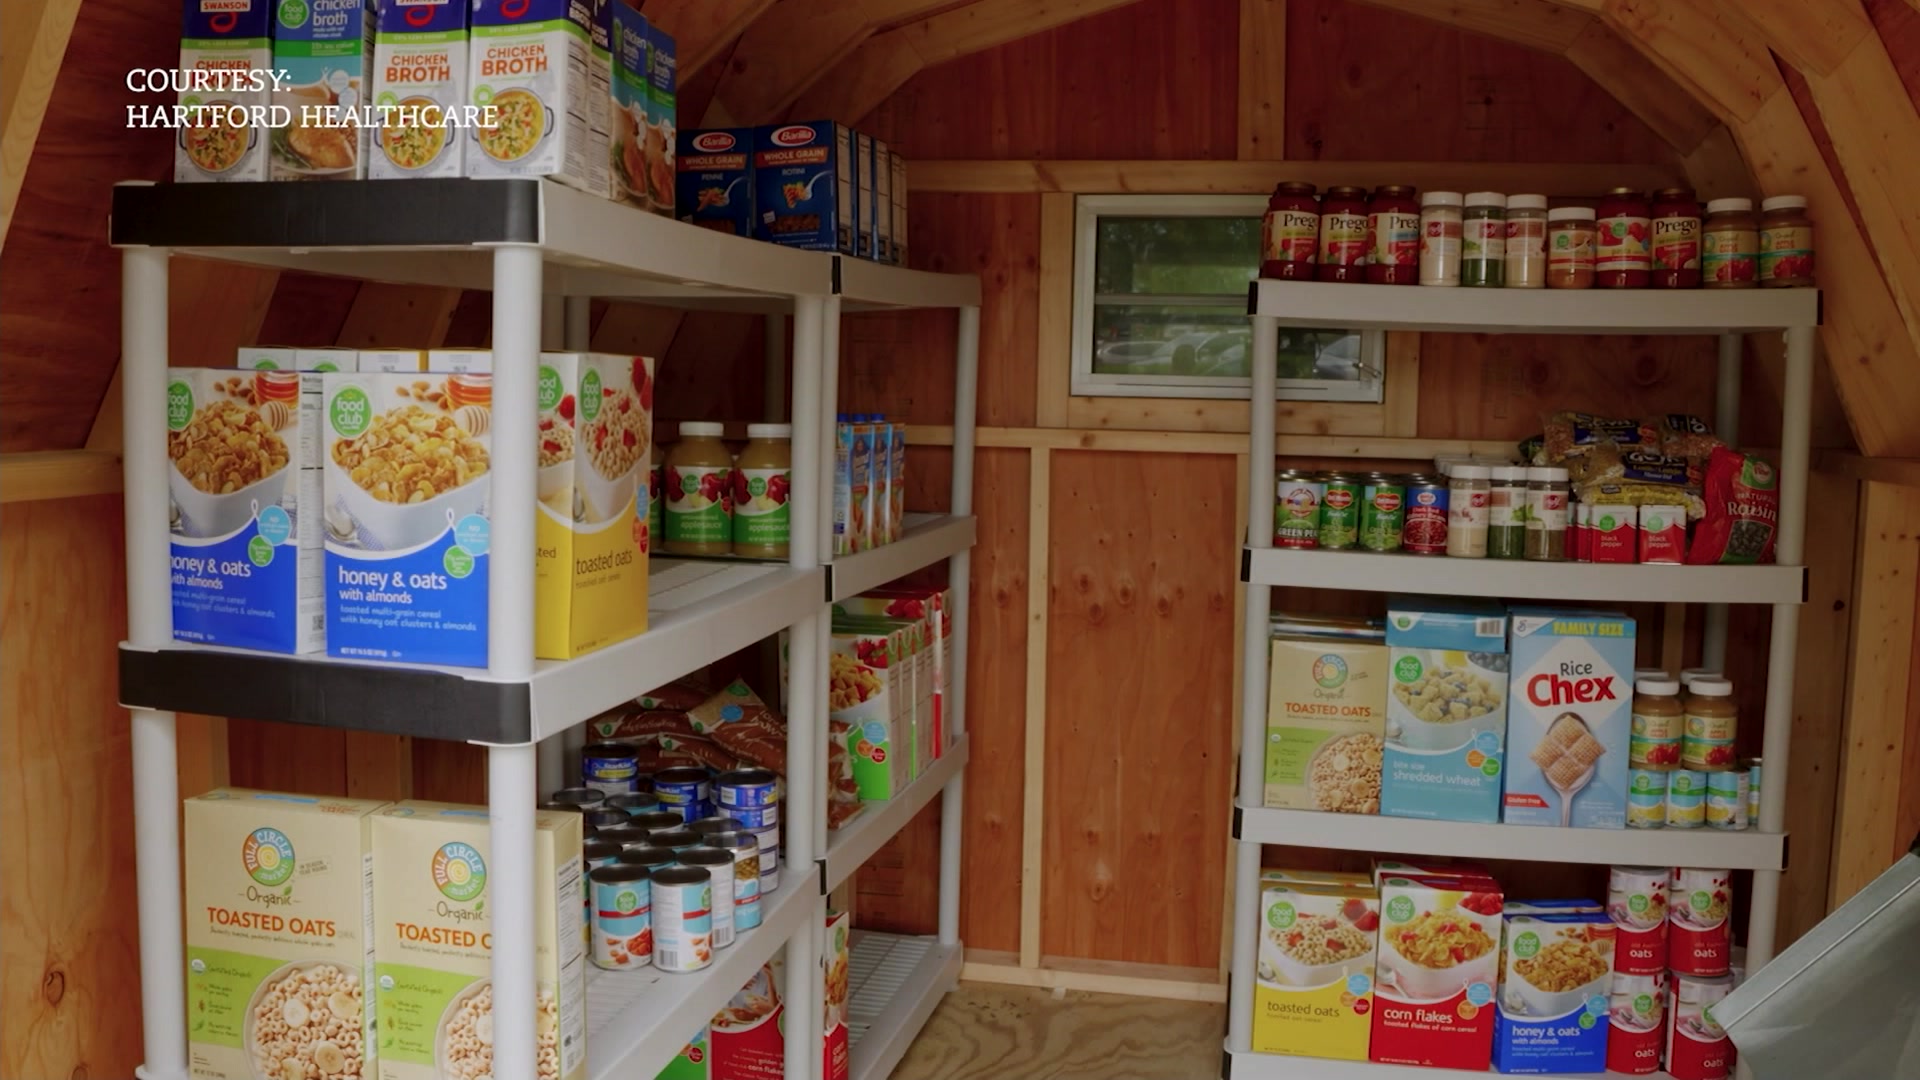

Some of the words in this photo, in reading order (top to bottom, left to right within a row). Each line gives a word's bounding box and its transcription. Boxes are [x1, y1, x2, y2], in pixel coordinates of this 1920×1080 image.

[203, 1, 248, 10] SWANSON
[313, 12, 348, 26] broth
[487, 44, 545, 59] CHICKEN
[391, 54, 448, 66] CHICKEN
[481, 56, 548, 76] BROTH
[386, 66, 450, 82] BROTH
[702, 137, 732, 147] Barilla
[780, 131, 812, 142] Barilla
[685, 157, 714, 165] WHOLE
[716, 156, 743, 164] GRAIN
[763, 152, 794, 161] WHOLE
[796, 149, 824, 158] GRAIN
[1330, 217, 1368, 232] Prego
[1390, 215, 1420, 231] Preg
[1655, 221, 1698, 236] Prego
[540, 376, 556, 388] ood
[336, 397, 364, 411] food
[337, 411, 363, 425] club
[207, 558, 218, 574] &
[221, 560, 251, 577] oats
[576, 551, 613, 575] toasted
[615, 549, 633, 566] oats
[187, 575, 223, 590] almonds
[338, 566, 388, 591] honey
[391, 571, 406, 588] &
[409, 572, 447, 590] oats
[339, 587, 363, 601] with
[365, 589, 413, 604] almonds
[340, 605, 370, 615] toasted
[417, 610, 441, 619] cereal
[340, 615, 358, 624] with
[360, 616, 382, 628] honey
[400, 619, 432, 629] clusters
[442, 622, 477, 631] almonds
[1553, 622, 1596, 635] FAMILY
[1599, 623, 1624, 636] SIZE
[1399, 660, 1418, 670] food
[1560, 661, 1593, 676] Rice
[1527, 673, 1617, 707] Chex
[1285, 702, 1338, 714] TOASTED
[1341, 706, 1371, 717] OATS
[1393, 771, 1443, 783] shredded
[1445, 775, 1481, 787] wheat
[245, 842, 259, 871] FULL
[256, 830, 291, 857] CIRCLE
[260, 863, 288, 881] market
[435, 856, 448, 886] FULL
[445, 846, 482, 873] CIRCLE
[450, 878, 480, 896] market
[246, 885, 291, 908] Organic
[436, 901, 484, 924] Organic
[1392, 902, 1411, 911] food
[207, 907, 284, 932] TOASTED
[289, 918, 336, 938] OATS
[395, 922, 476, 948] TOASTED
[1629, 949, 1653, 959] oats
[1694, 948, 1717, 958] oats
[1267, 1000, 1312, 1015] toasted
[1314, 1006, 1340, 1018] oats
[1384, 1008, 1412, 1021] corn
[1415, 1009, 1453, 1024] flakes
[1512, 1025, 1547, 1039] honey
[1547, 1027, 1555, 1037] &
[1557, 1027, 1580, 1037] oats
[1512, 1037, 1528, 1045] with
[1529, 1037, 1559, 1045] almonds
[1634, 1048, 1656, 1058] oats
[1703, 1059, 1725, 1068] oats
